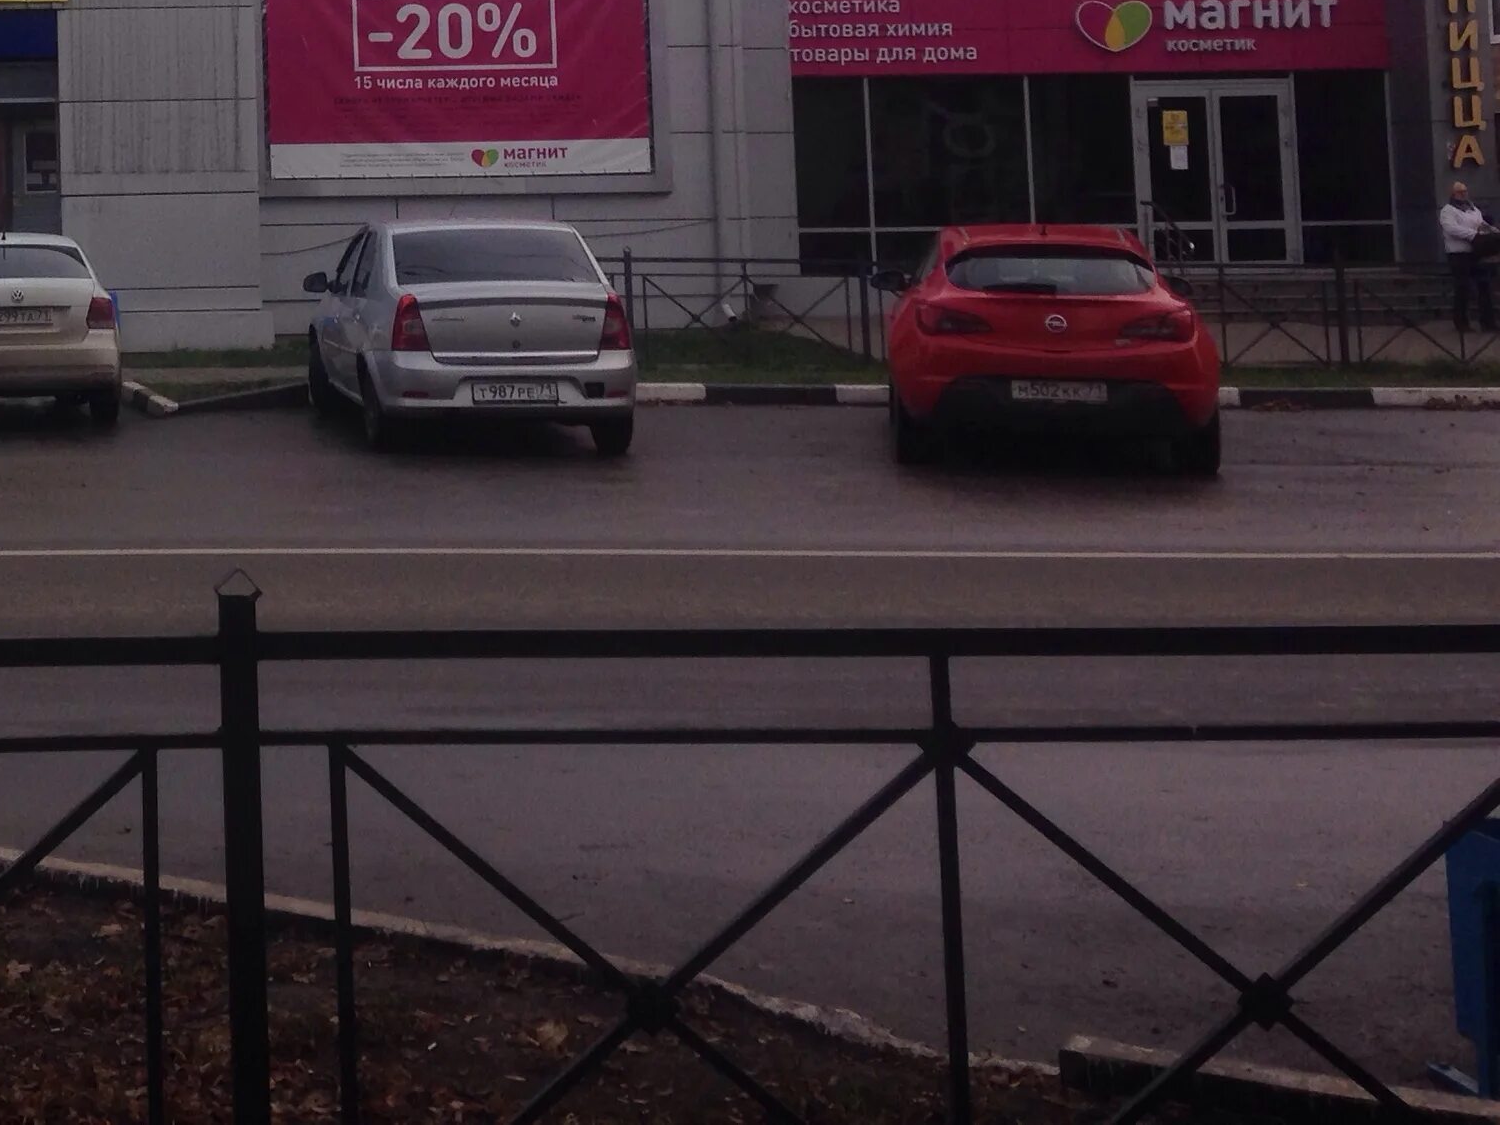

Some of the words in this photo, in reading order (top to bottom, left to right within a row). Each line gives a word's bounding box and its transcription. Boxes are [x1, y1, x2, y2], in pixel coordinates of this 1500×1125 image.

[368, 2, 537, 60] -20%
[789, 20, 880, 38] бытовая
[886, 22, 953, 37] химия
[1166, 36, 1257, 53] косметик
[789, 47, 870, 65] товары
[876, 47, 916, 64] для
[922, 46, 978, 64] дома
[354, 75, 373, 90] 15
[376, 76, 423, 90] числа
[427, 76, 496, 92] каждого
[500, 74, 559, 89] месяца
[503, 146, 569, 161] магнит
